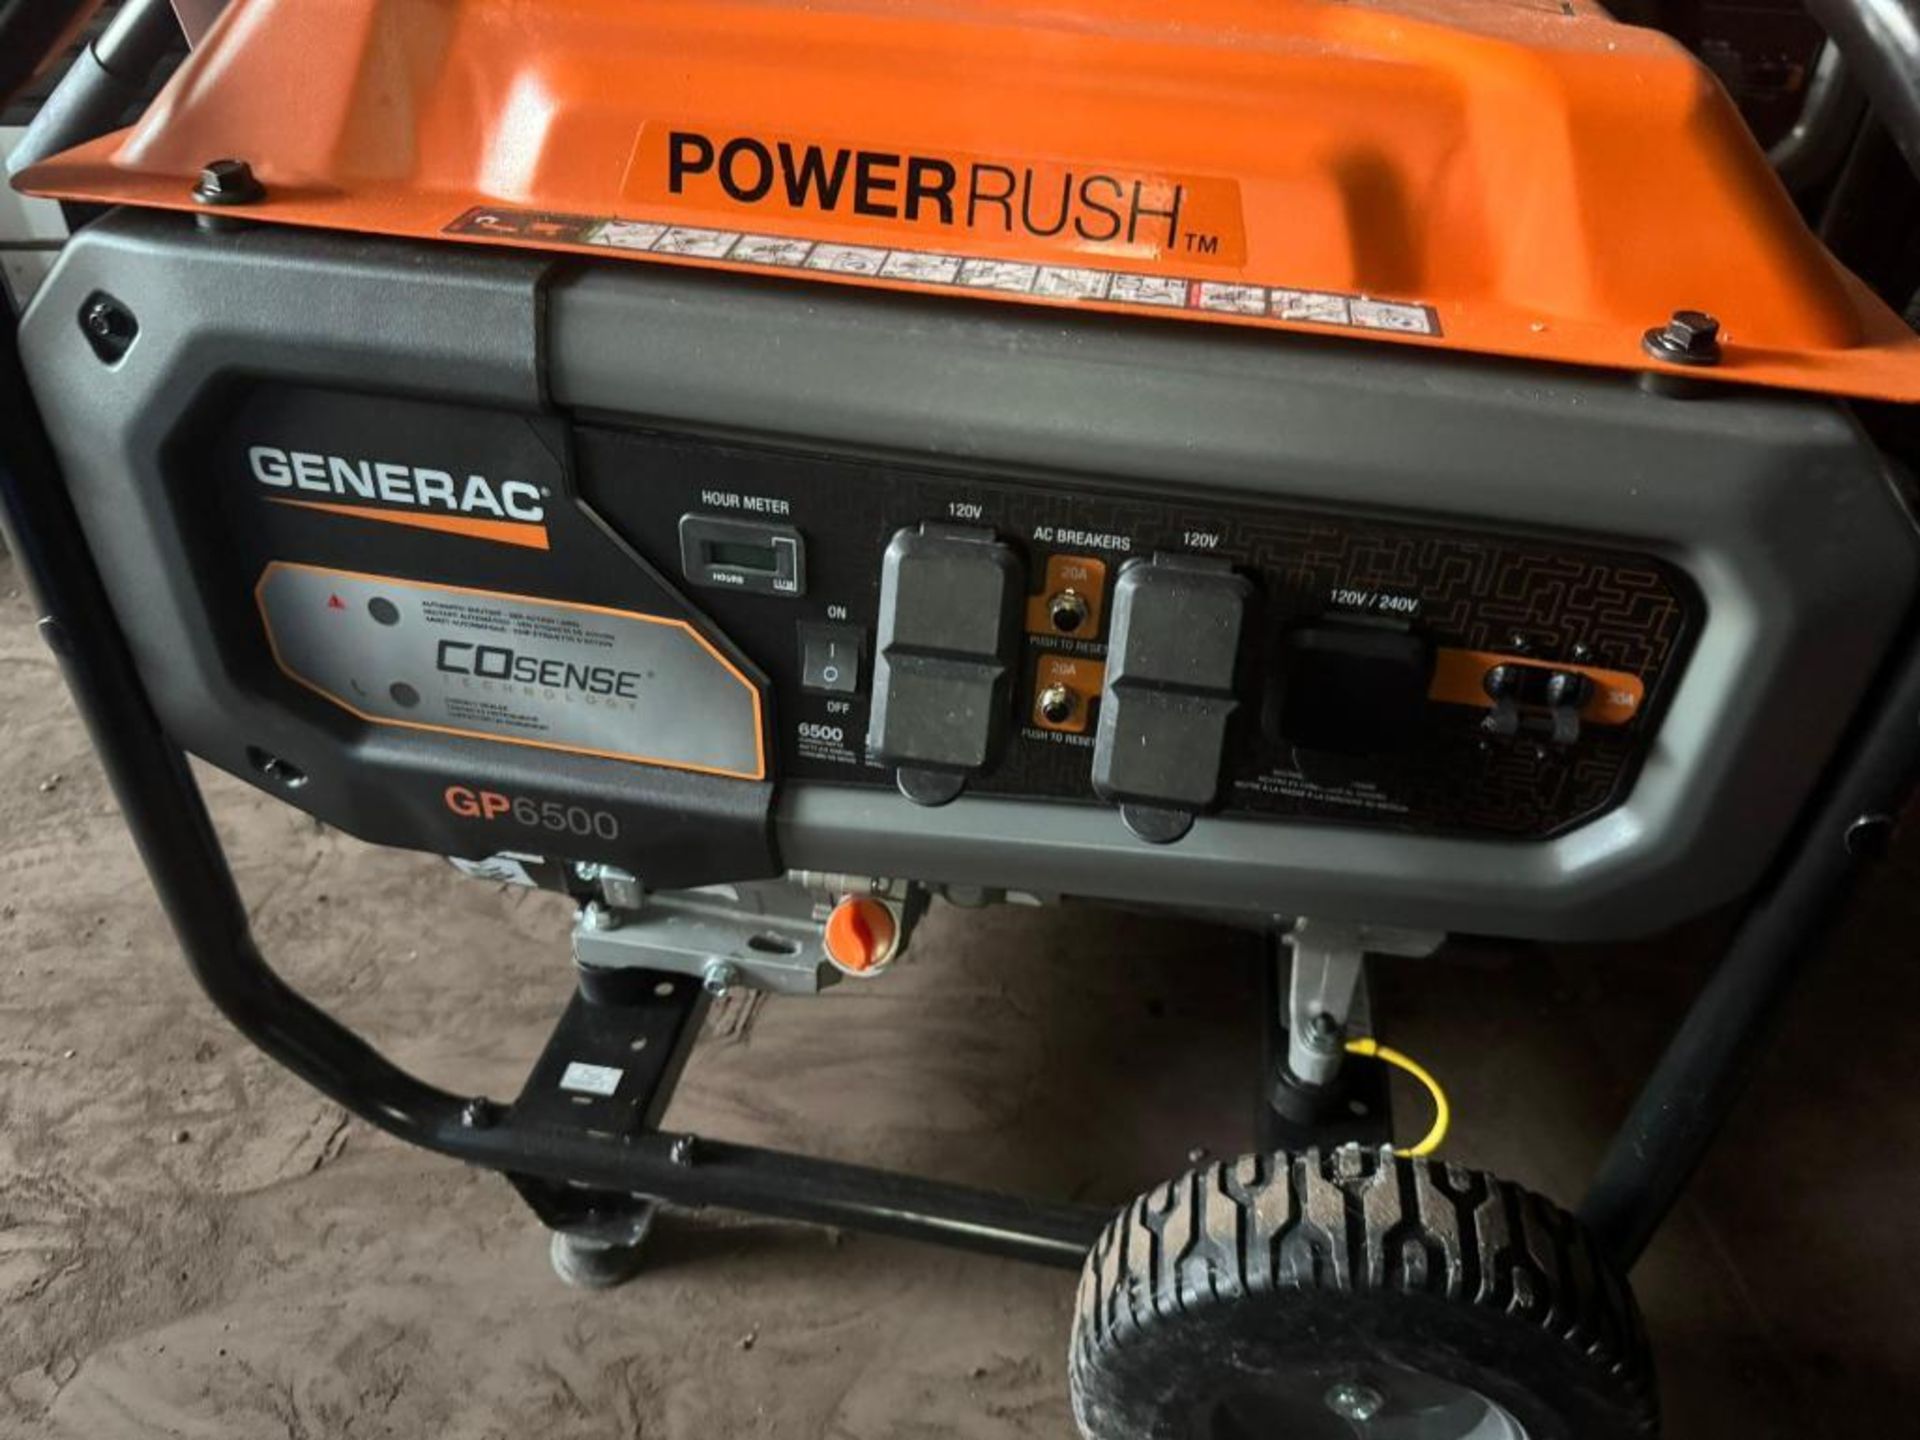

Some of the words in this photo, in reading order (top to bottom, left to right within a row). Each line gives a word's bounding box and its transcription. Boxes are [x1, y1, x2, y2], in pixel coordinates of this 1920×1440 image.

[248, 446, 545, 522] GENERAC
[702, 489, 741, 509] HOUR
[743, 496, 789, 516] METER
[949, 502, 983, 519] 120V
[1033, 526, 1054, 541] AC
[1057, 528, 1132, 551] BREAKERS
[1184, 531, 1219, 549] 120V
[1331, 588, 1368, 606] 120V
[1379, 594, 1419, 613] 240V
[827, 605, 847, 620] ON
[1061, 640, 1075, 651] TO
[826, 701, 850, 715] OFF
[798, 721, 844, 743] 6500
[1021, 727, 1048, 741] PUSH
[1050, 732, 1063, 744] TO
[444, 785, 619, 840] GP6500
